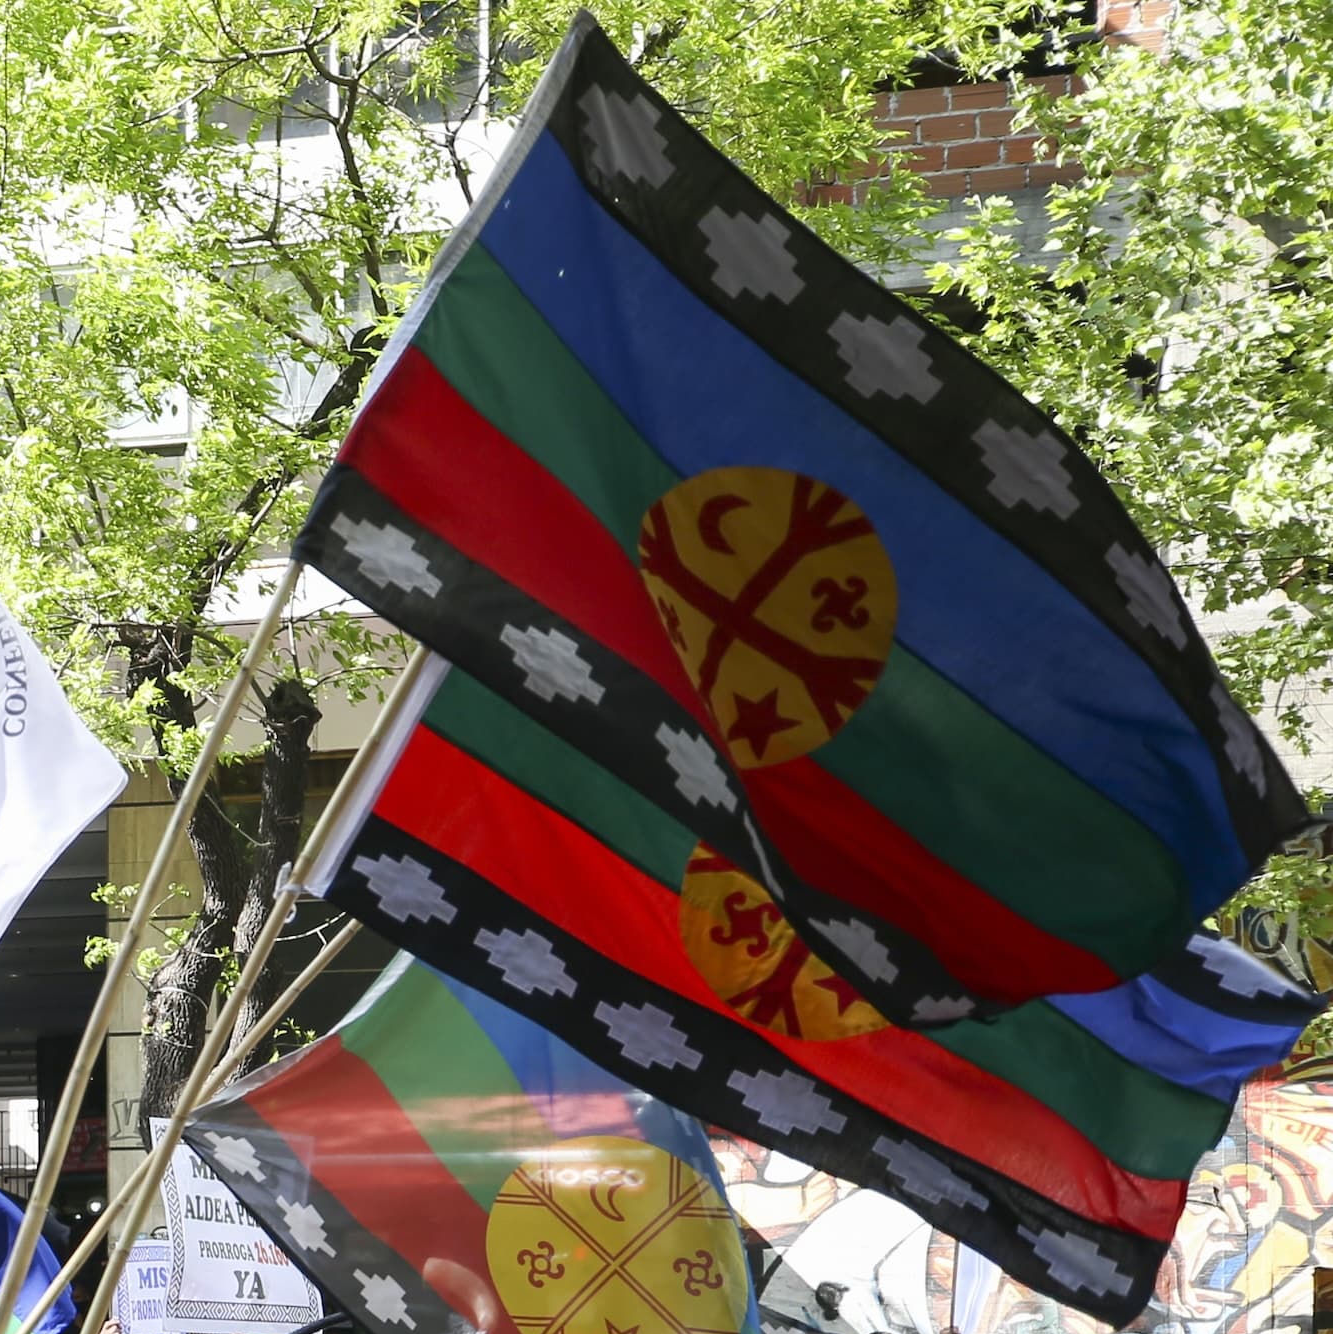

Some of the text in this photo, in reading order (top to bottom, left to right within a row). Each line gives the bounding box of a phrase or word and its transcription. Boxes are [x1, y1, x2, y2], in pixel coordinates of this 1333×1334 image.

[184, 1194, 234, 1224] ALDEA
[199, 1240, 255, 1262] PRORROGA
[233, 1270, 266, 1300] YA
